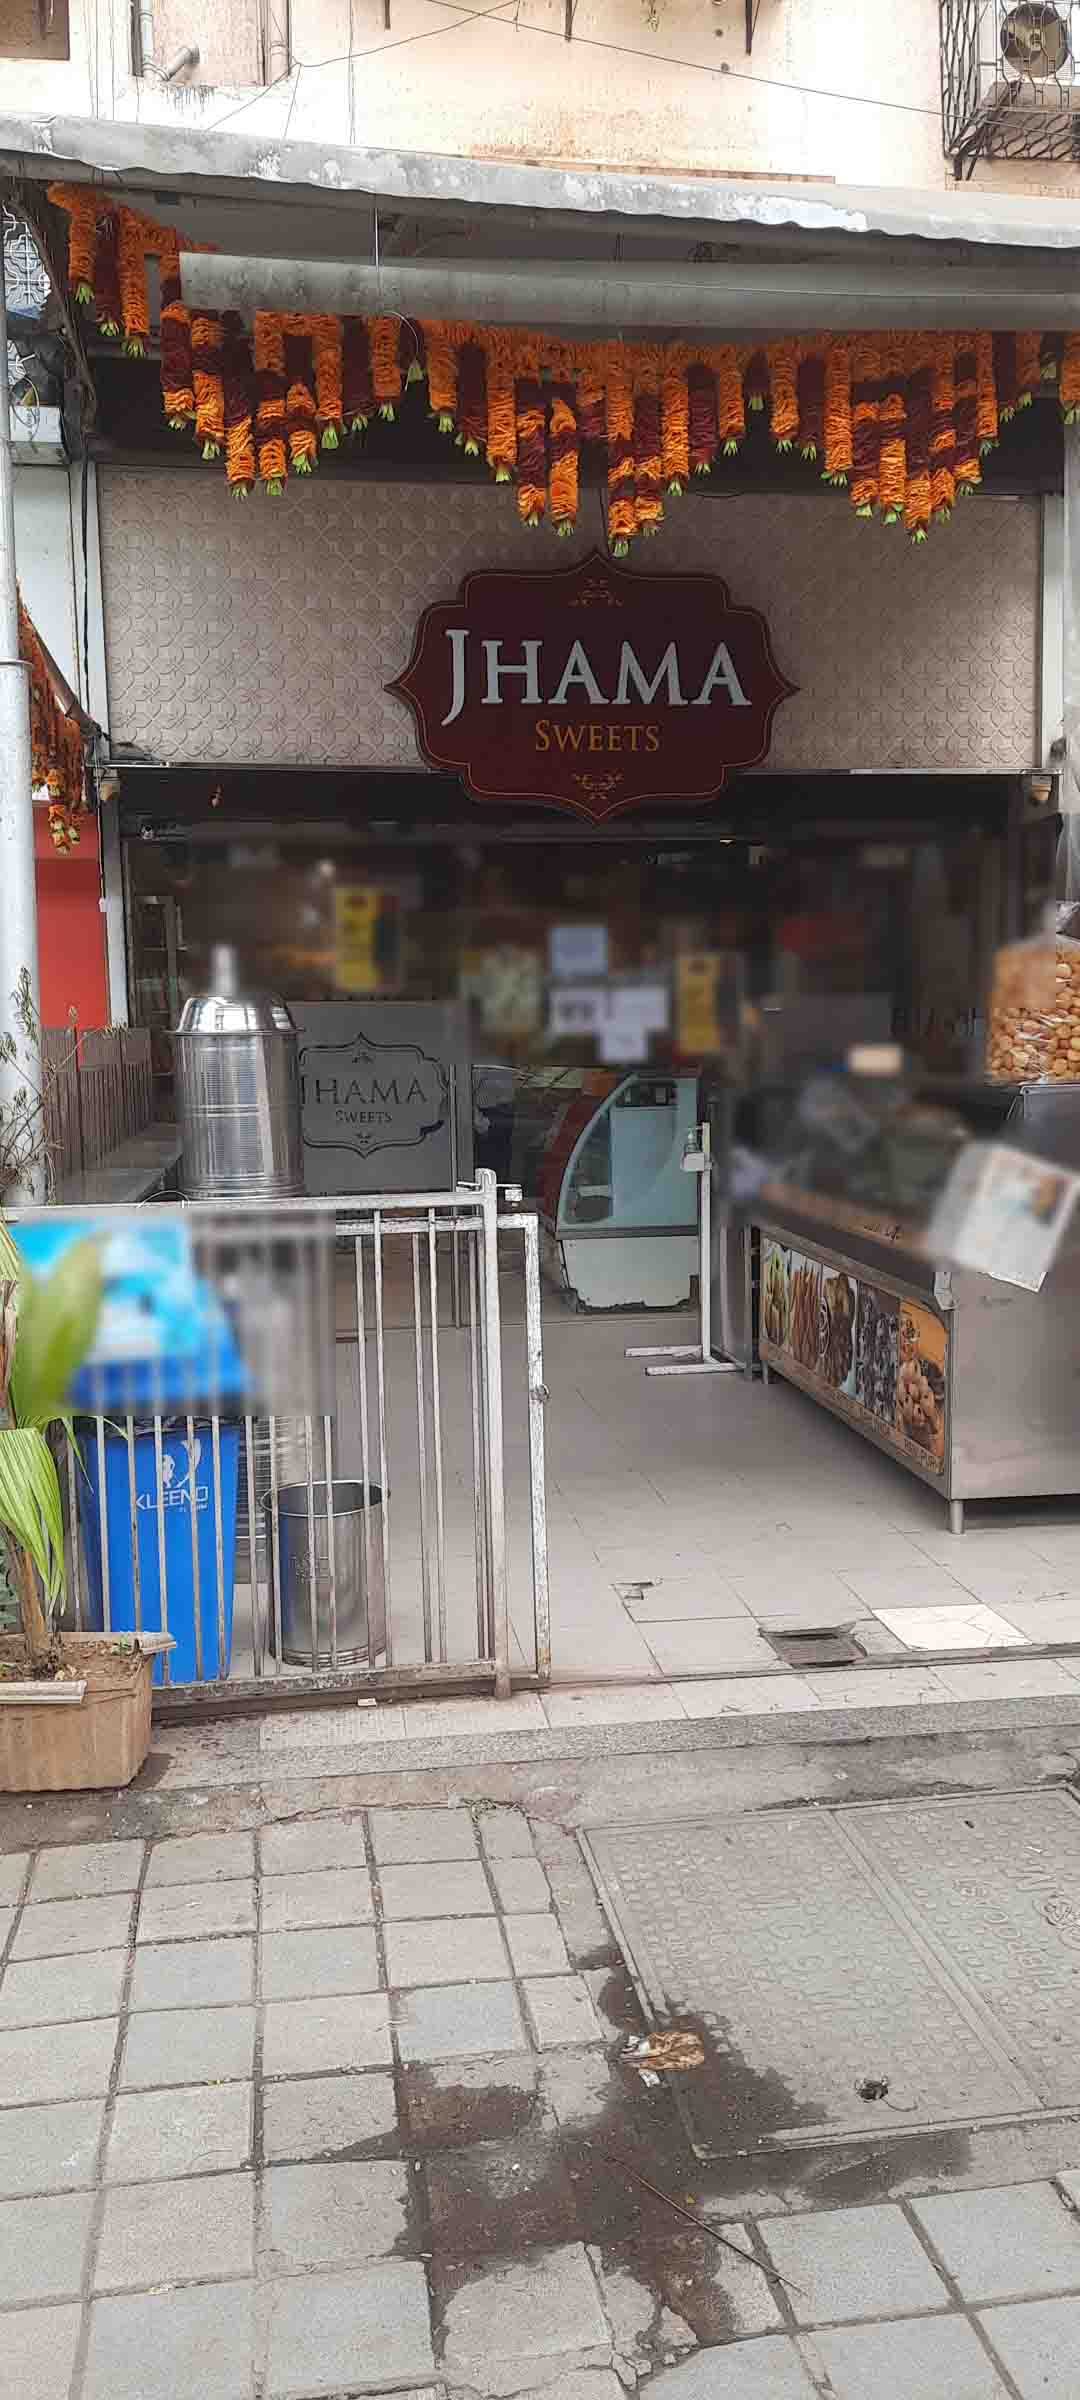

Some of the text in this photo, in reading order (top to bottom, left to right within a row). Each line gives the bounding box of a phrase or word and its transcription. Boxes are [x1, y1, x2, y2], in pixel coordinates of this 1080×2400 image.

[441, 629, 752, 726] JHAMA
[535, 719, 660, 752] SWEETS
[336, 1110, 392, 1123] SWEETS
